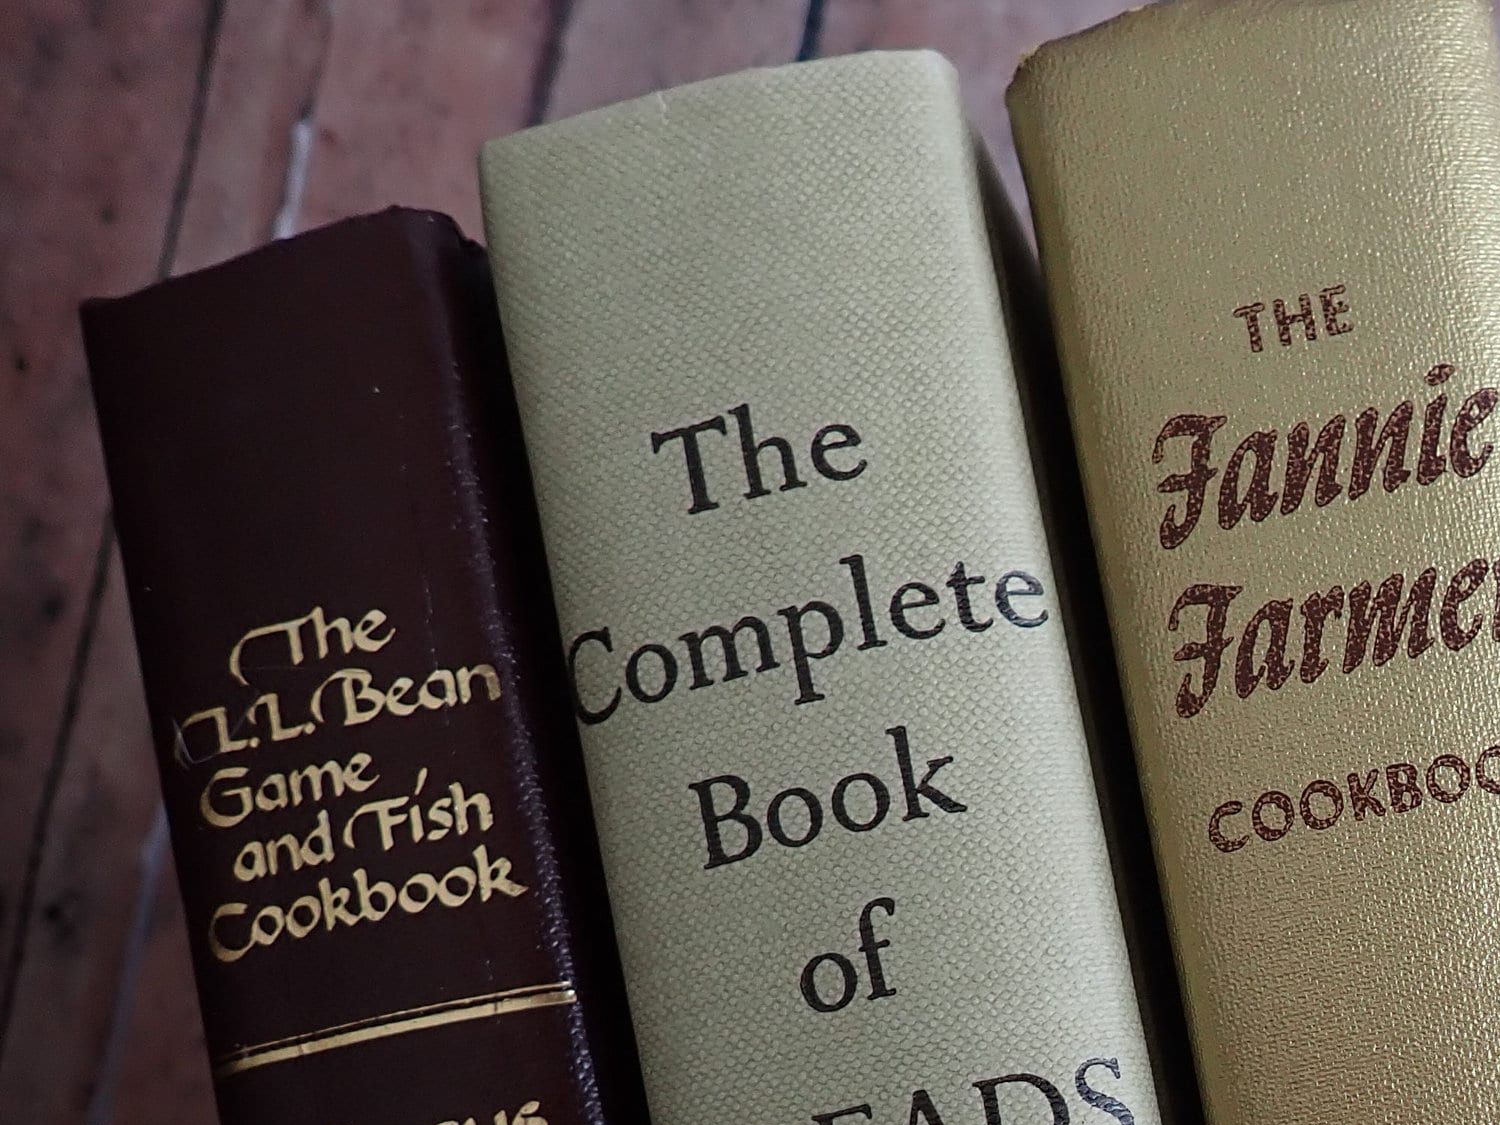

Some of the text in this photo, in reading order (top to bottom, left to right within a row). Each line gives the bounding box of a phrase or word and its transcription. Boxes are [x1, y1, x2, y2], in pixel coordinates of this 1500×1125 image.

[1233, 284, 1354, 353] THE
[650, 403, 868, 515] The
[1151, 362, 1500, 550] Fannie
[229, 606, 396, 687] The
[568, 553, 1049, 726] Complete
[178, 662, 504, 756] L.L. Bean
[201, 751, 381, 829] Game
[233, 767, 495, 883] and Fish
[687, 725, 968, 871] Book
[208, 844, 530, 963] Cookbook
[800, 898, 897, 1014] of
